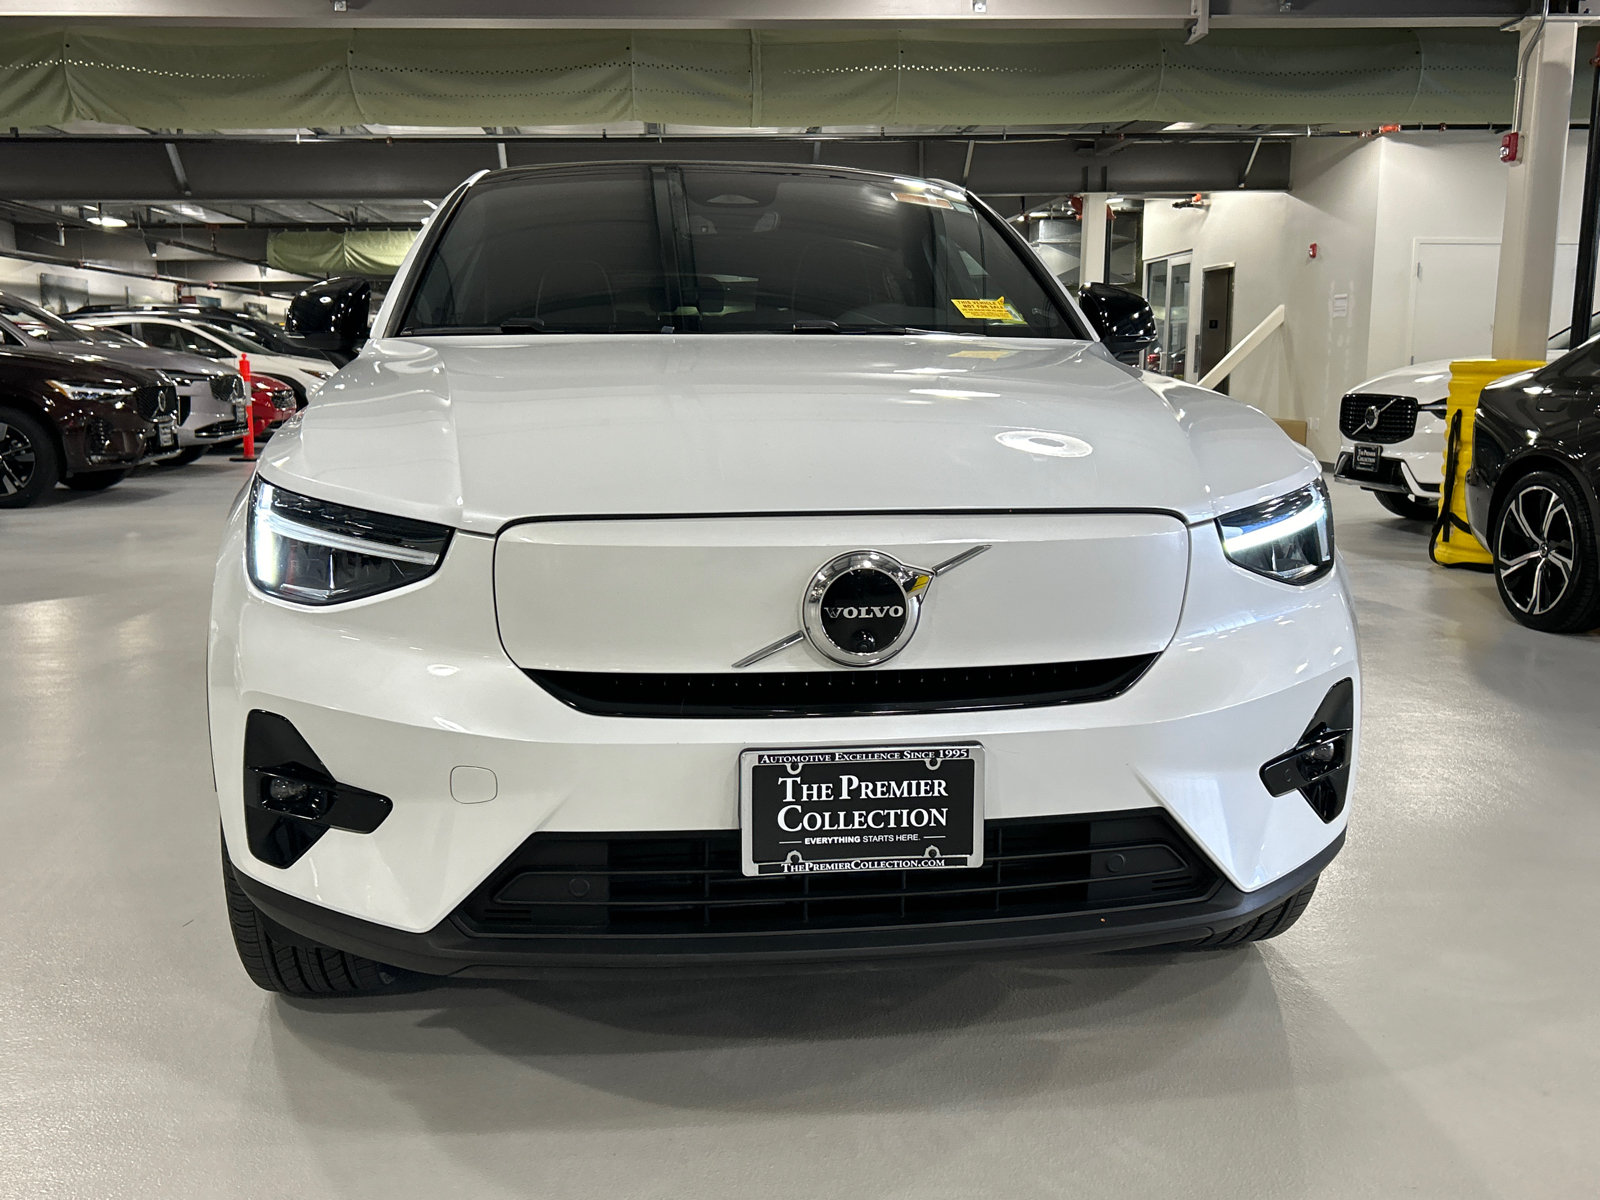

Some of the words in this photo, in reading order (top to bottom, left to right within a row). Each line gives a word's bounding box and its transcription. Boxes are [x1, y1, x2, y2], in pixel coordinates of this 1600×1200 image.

[824, 605, 904, 619] VOLVO
[760, 754, 831, 764] AUTOMOTIVE
[835, 752, 900, 761] EXCELLENCE
[903, 750, 935, 759] SINCE
[939, 749, 968, 758] 1995
[778, 776, 834, 802] THE
[839, 774, 948, 800] PREMIER
[777, 804, 948, 832] COLLECTION
[804, 836, 861, 845] EVERYTHING
[862, 834, 894, 843] STARTS
[895, 833, 921, 842] HERE.
